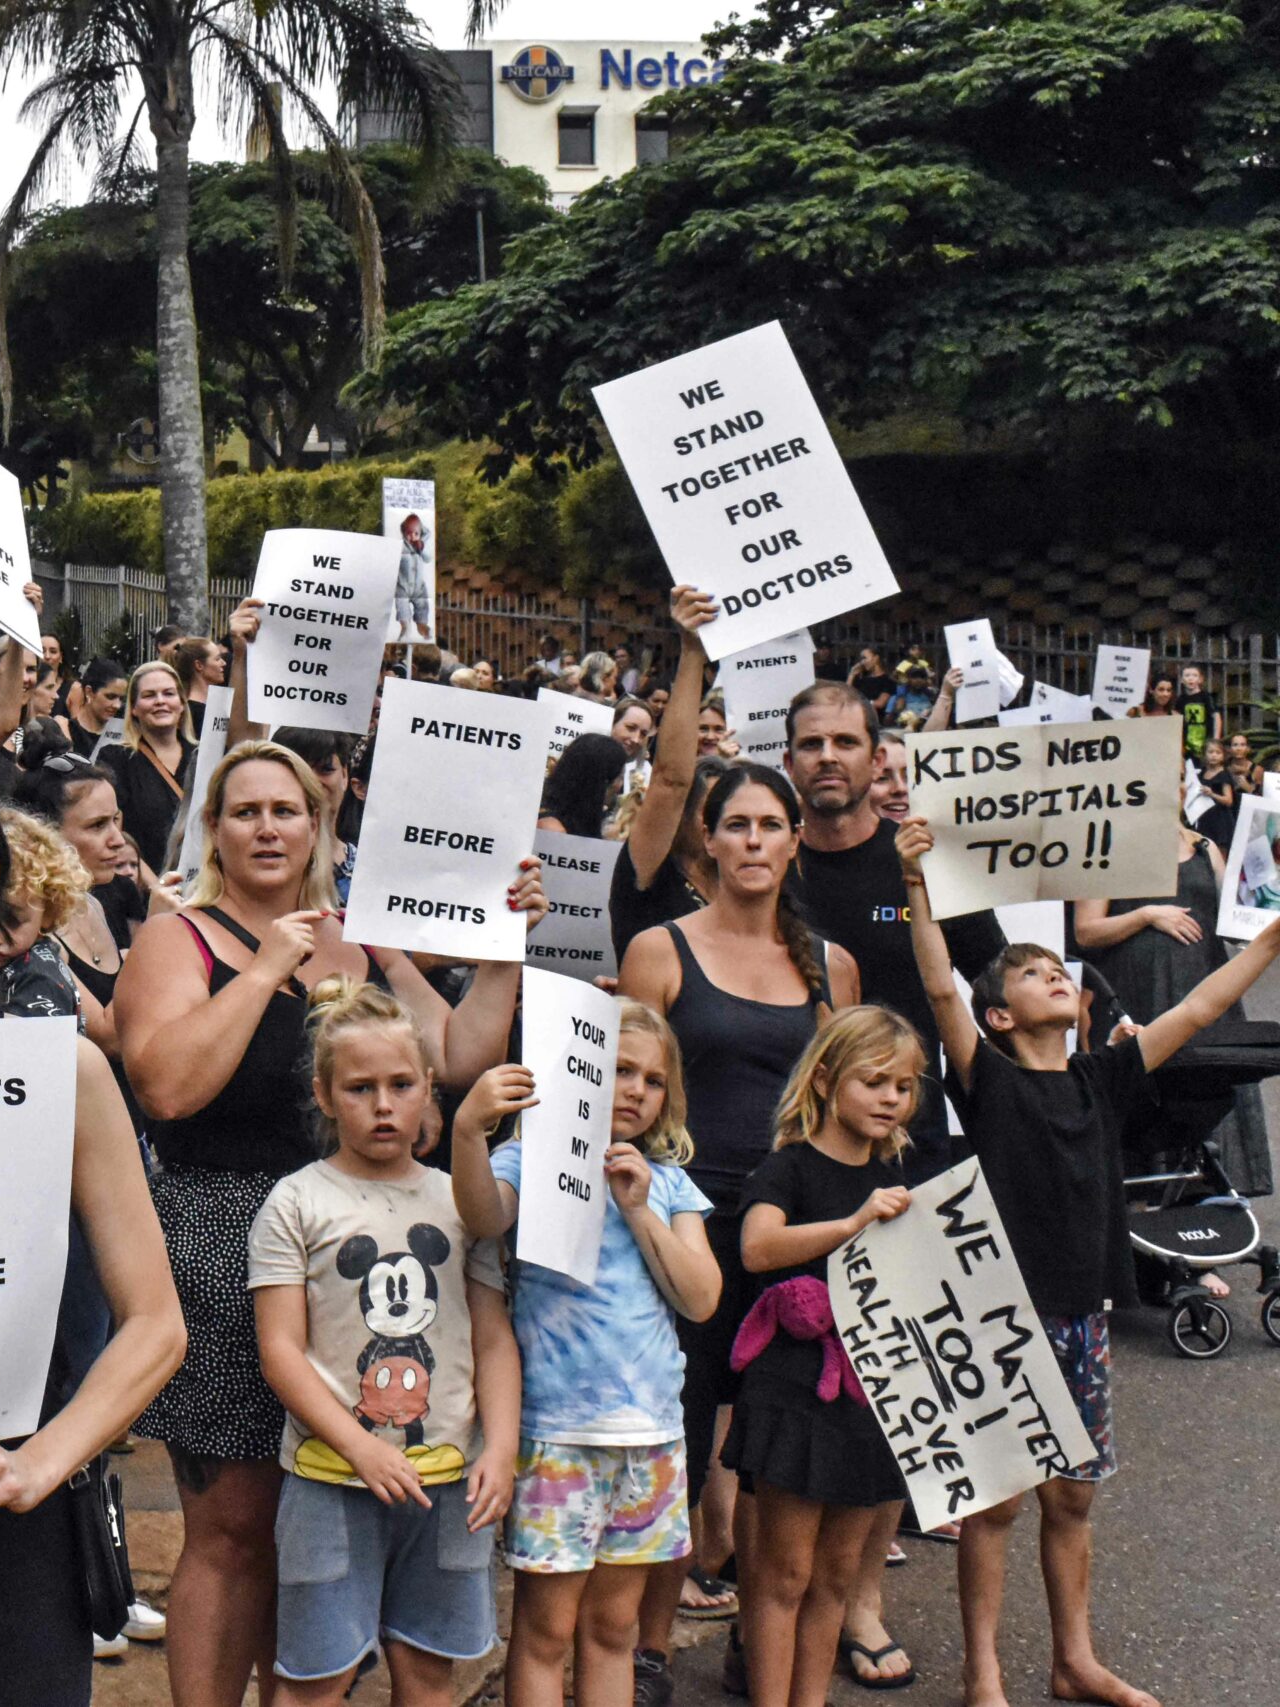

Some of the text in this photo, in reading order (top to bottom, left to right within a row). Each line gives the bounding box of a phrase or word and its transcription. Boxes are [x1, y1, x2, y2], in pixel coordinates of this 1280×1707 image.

[507, 66, 569, 77] NETCARE
[679, 379, 725, 409] WE
[673, 409, 765, 456] STAND
[661, 436, 811, 503] TOGETHER
[724, 491, 783, 526] FOR
[741, 529, 803, 564] OUR
[312, 555, 342, 571] WE
[290, 579, 354, 600] STAND
[722, 554, 853, 616] DOCTORS
[267, 603, 369, 631] TOGETHER
[293, 634, 332, 651] FOR
[288, 659, 328, 677] OUR
[737, 655, 798, 670] PATIENTS
[263, 684, 348, 706] DOCTORS
[567, 711, 584, 724] WE
[748, 708, 791, 721] BEFOR
[410, 716, 522, 751] PATIENTS
[554, 726, 583, 738] STAN
[748, 741, 788, 753] PROFIT
[912, 735, 1121, 790] KIDS NEED
[955, 779, 1148, 825] HOSPITALS
[403, 825, 495, 855] BEFORE
[537, 852, 601, 874] PLEASE
[386, 894, 487, 925] PROFITS
[548, 901, 602, 920] OTECT
[525, 944, 604, 962] VERYONE
[571, 1016, 606, 1050] YOUR
[567, 1055, 603, 1087] CHILD
[578, 1099, 590, 1120] IS
[571, 1136, 589, 1160] MY
[558, 1171, 591, 1202] CHILD
[935, 1167, 1070, 1479] WE MATTER
[842, 1323, 928, 1477] HEALTH
[910, 1396, 975, 1514] OVER
